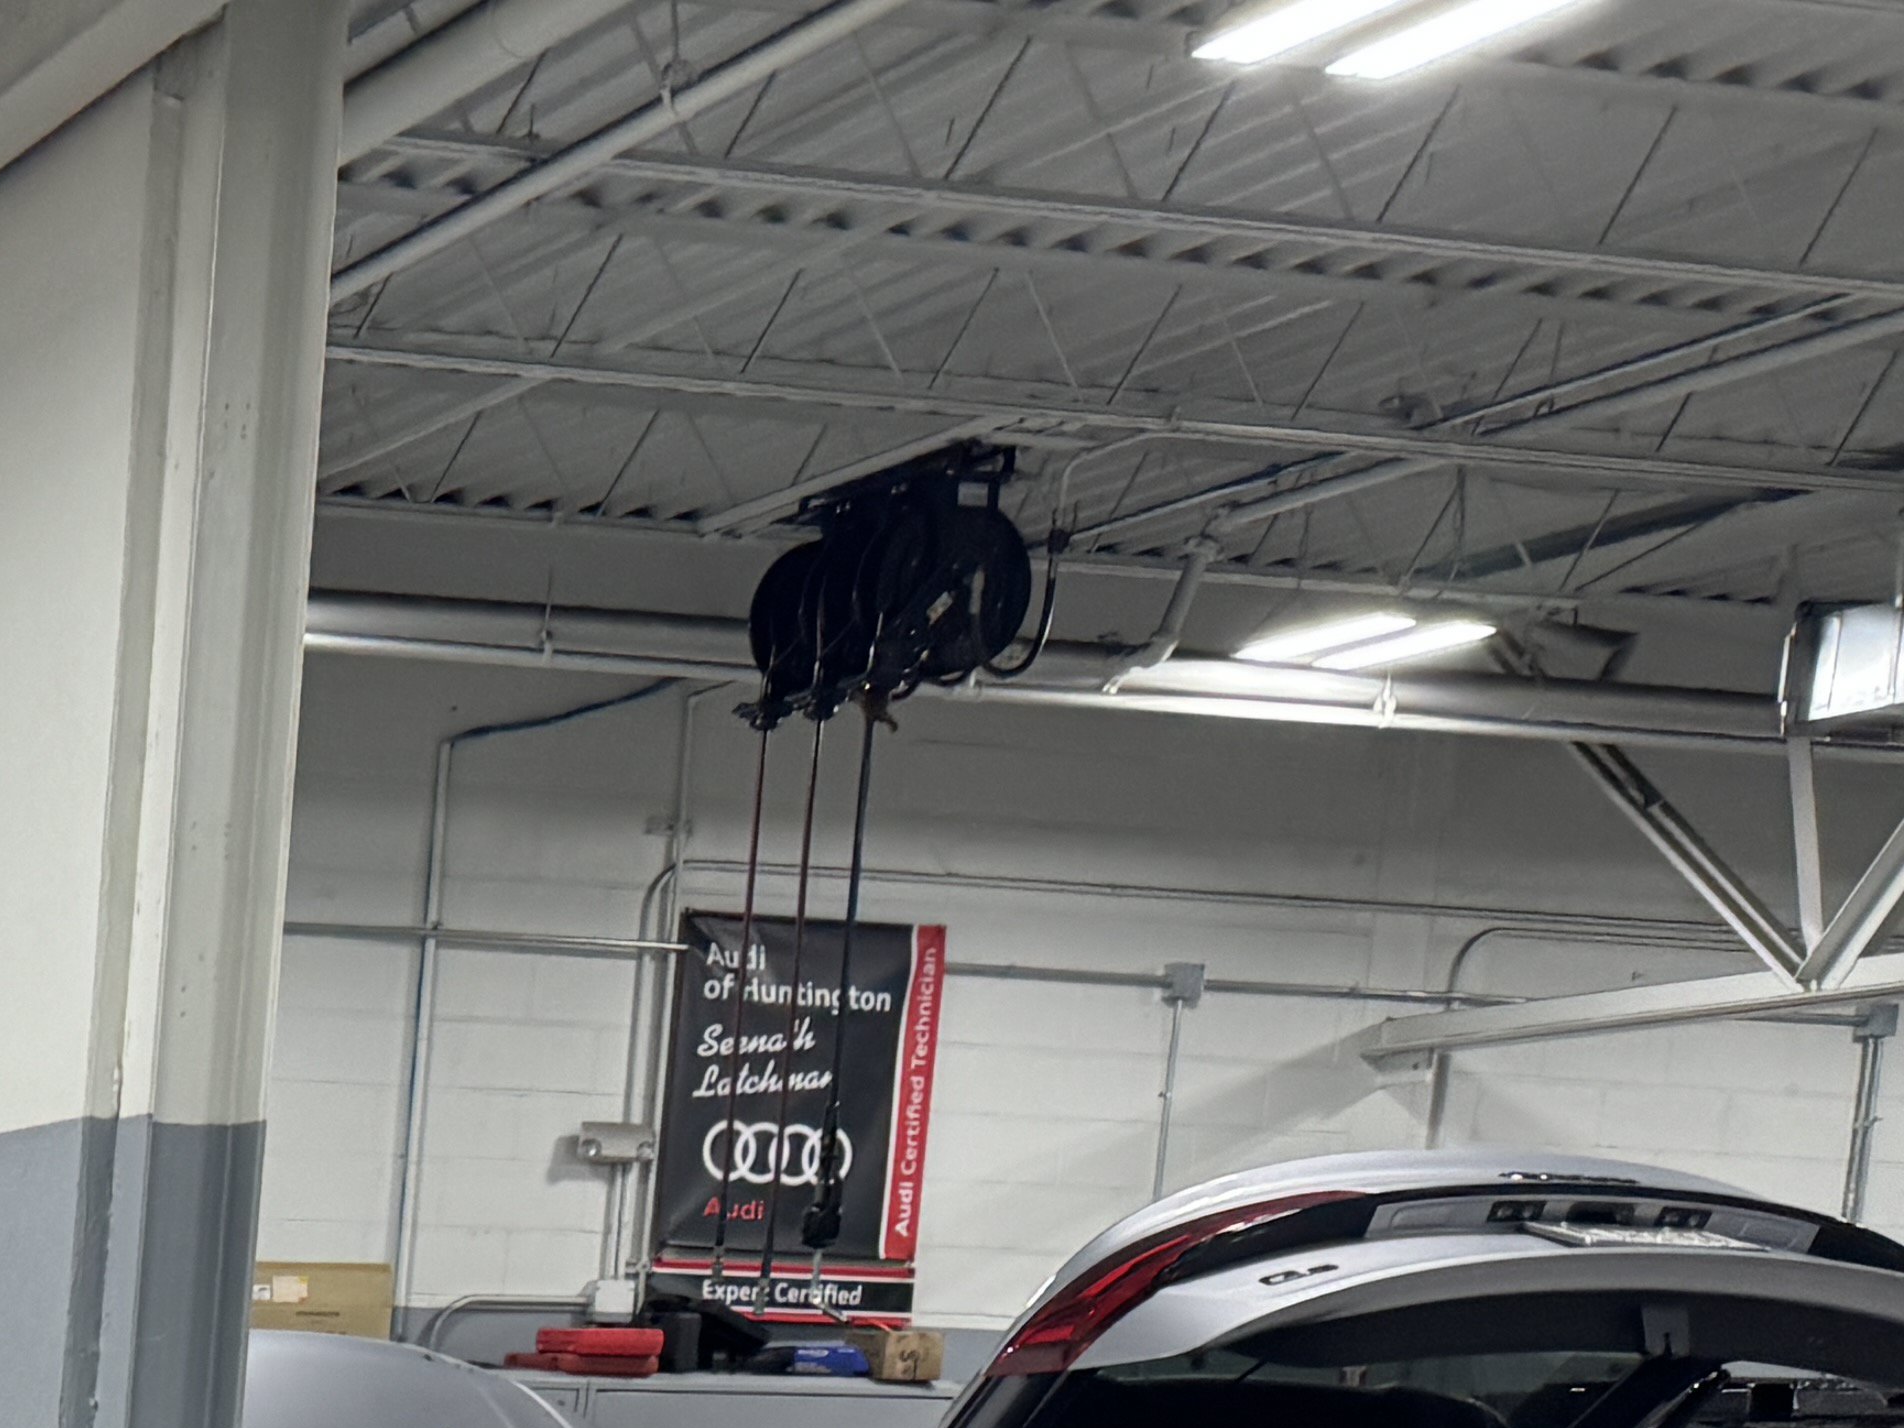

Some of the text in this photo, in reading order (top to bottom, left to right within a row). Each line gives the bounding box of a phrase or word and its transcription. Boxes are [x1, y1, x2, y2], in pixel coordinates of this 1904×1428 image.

[706, 942, 766, 970] Audi
[703, 973, 734, 1000] of
[895, 947, 937, 1237] Audi Certified Technician
[703, 1195, 766, 1221] Audi
